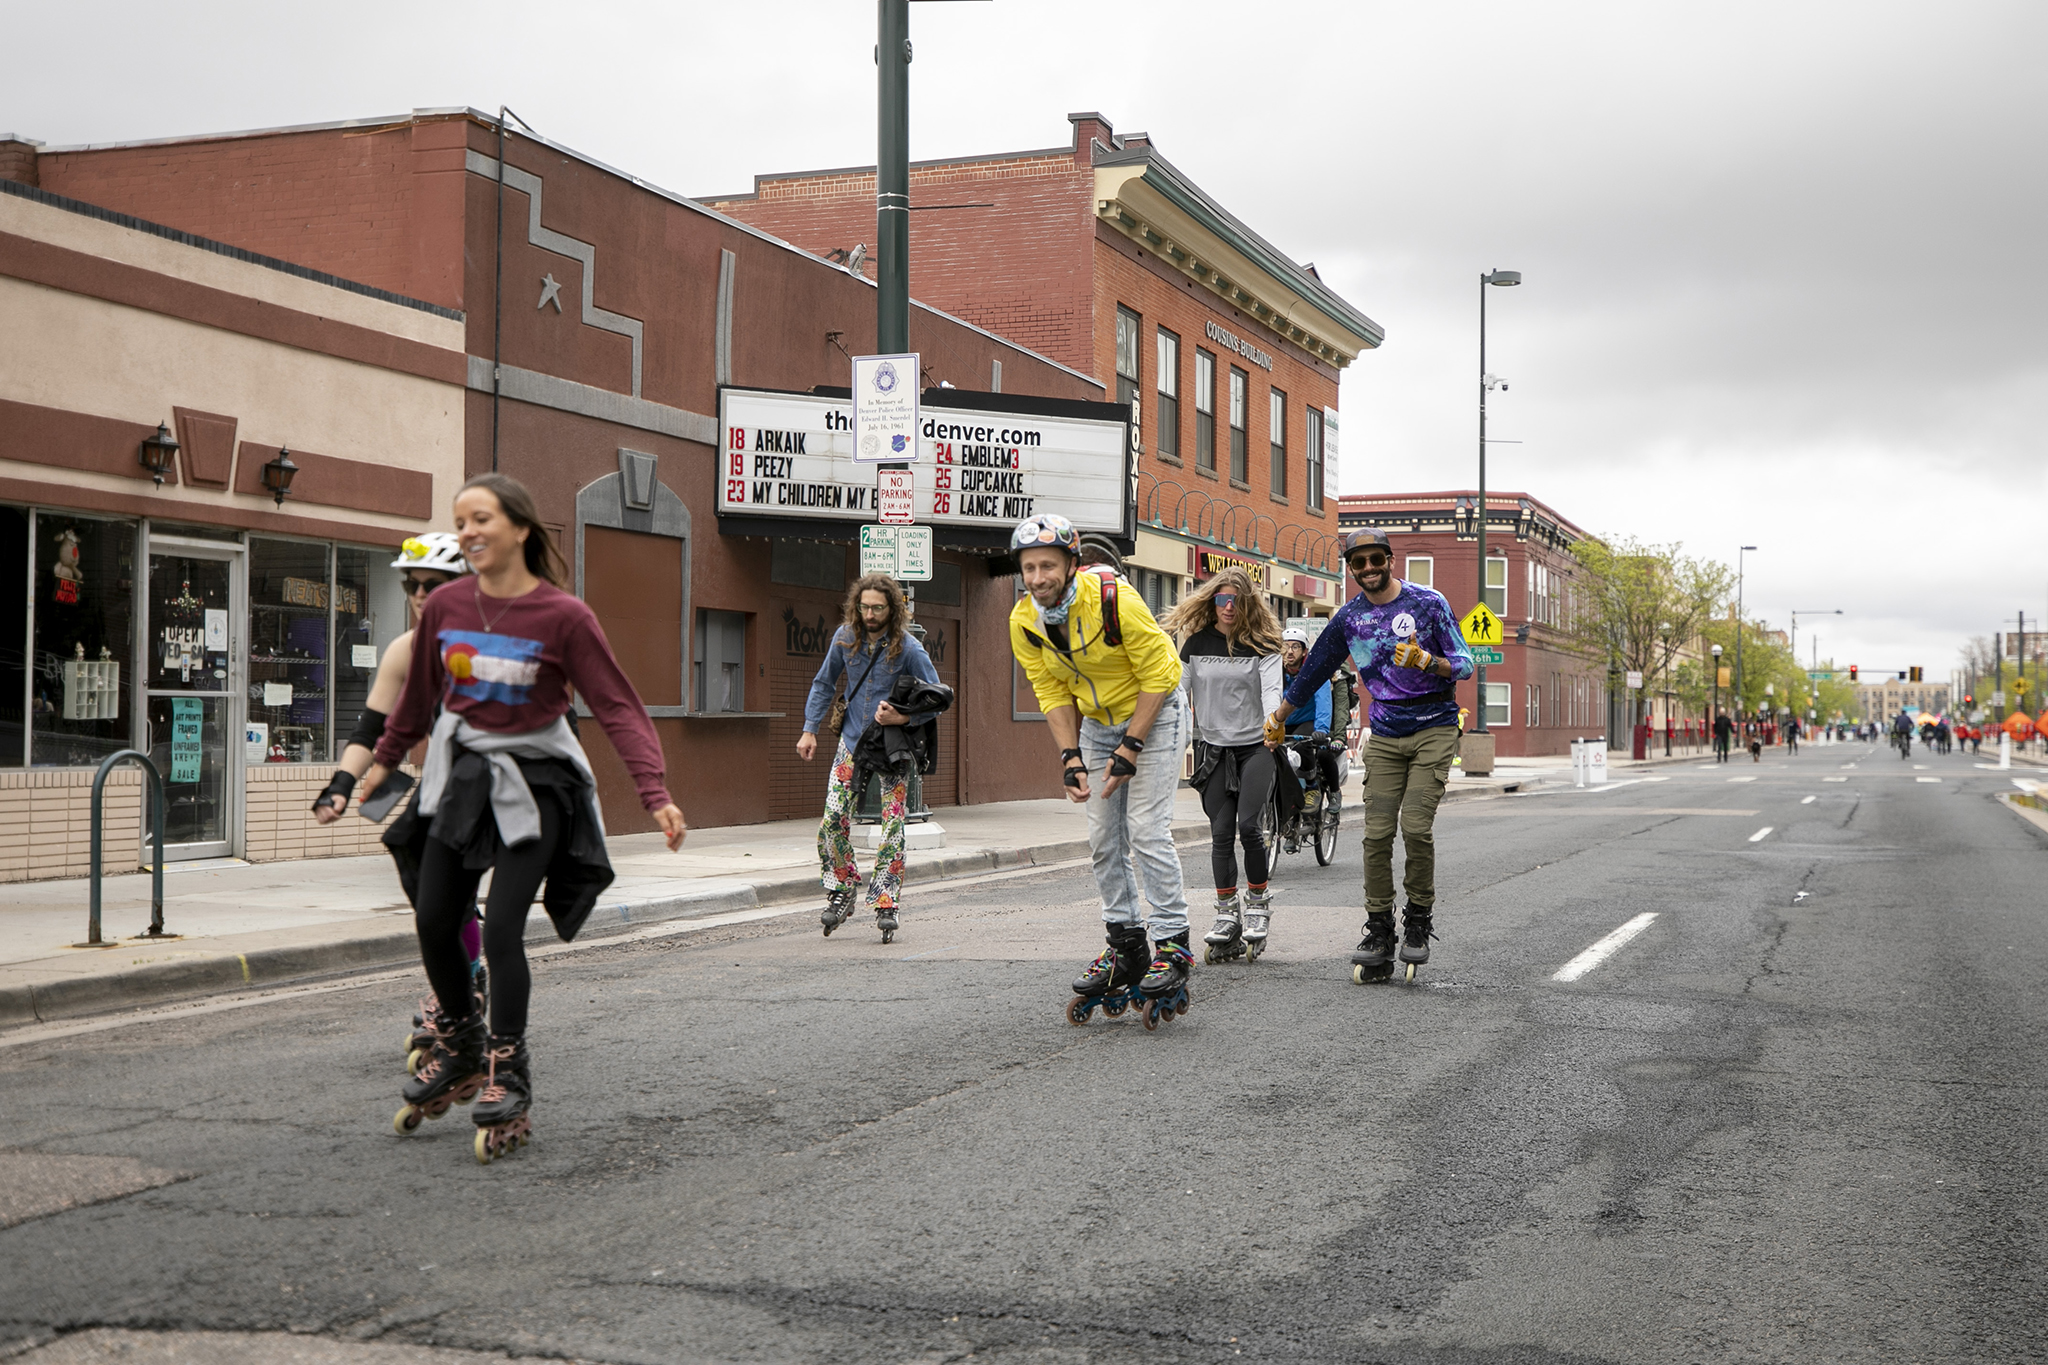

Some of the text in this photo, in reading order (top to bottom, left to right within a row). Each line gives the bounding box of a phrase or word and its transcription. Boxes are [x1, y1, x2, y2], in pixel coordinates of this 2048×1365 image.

[1206, 320, 1273, 371] COUSINS BUILDING
[729, 427, 806, 455] 18 ARKAIK
[936, 443, 1019, 469] 24 EMBLEM3
[1131, 400, 1141, 501] ROXY
[729, 453, 794, 479] 19 PEEZY
[890, 477, 903, 487] NO
[936, 468, 1024, 494] 25 CUPCAKKE
[727, 480, 745, 502] 23
[752, 481, 773, 504] MY
[778, 482, 843, 507] CHILDREN
[846, 487, 866, 509] MY
[881, 489, 913, 499] PARKING
[934, 492, 1034, 519] 26 LANCE NOTE
[863, 529, 887, 545] 2 HR
[901, 531, 928, 539] LOADING
[870, 538, 895, 547] PARKING
[168, 625, 199, 643] OPEN
[786, 614, 829, 653] ROXY
[157, 640, 181, 659] WED
[1200, 656, 1253, 665] DYNAFIT
[1470, 653, 1492, 663] 26th
[184, 700, 194, 708] ALL
[175, 713, 201, 722] ART PRINTS
[178, 724, 198, 735] FRAMED
[173, 742, 200, 752] UNFRAMED
[174, 753, 188, 762] ARE
[177, 769, 195, 779] SALE
